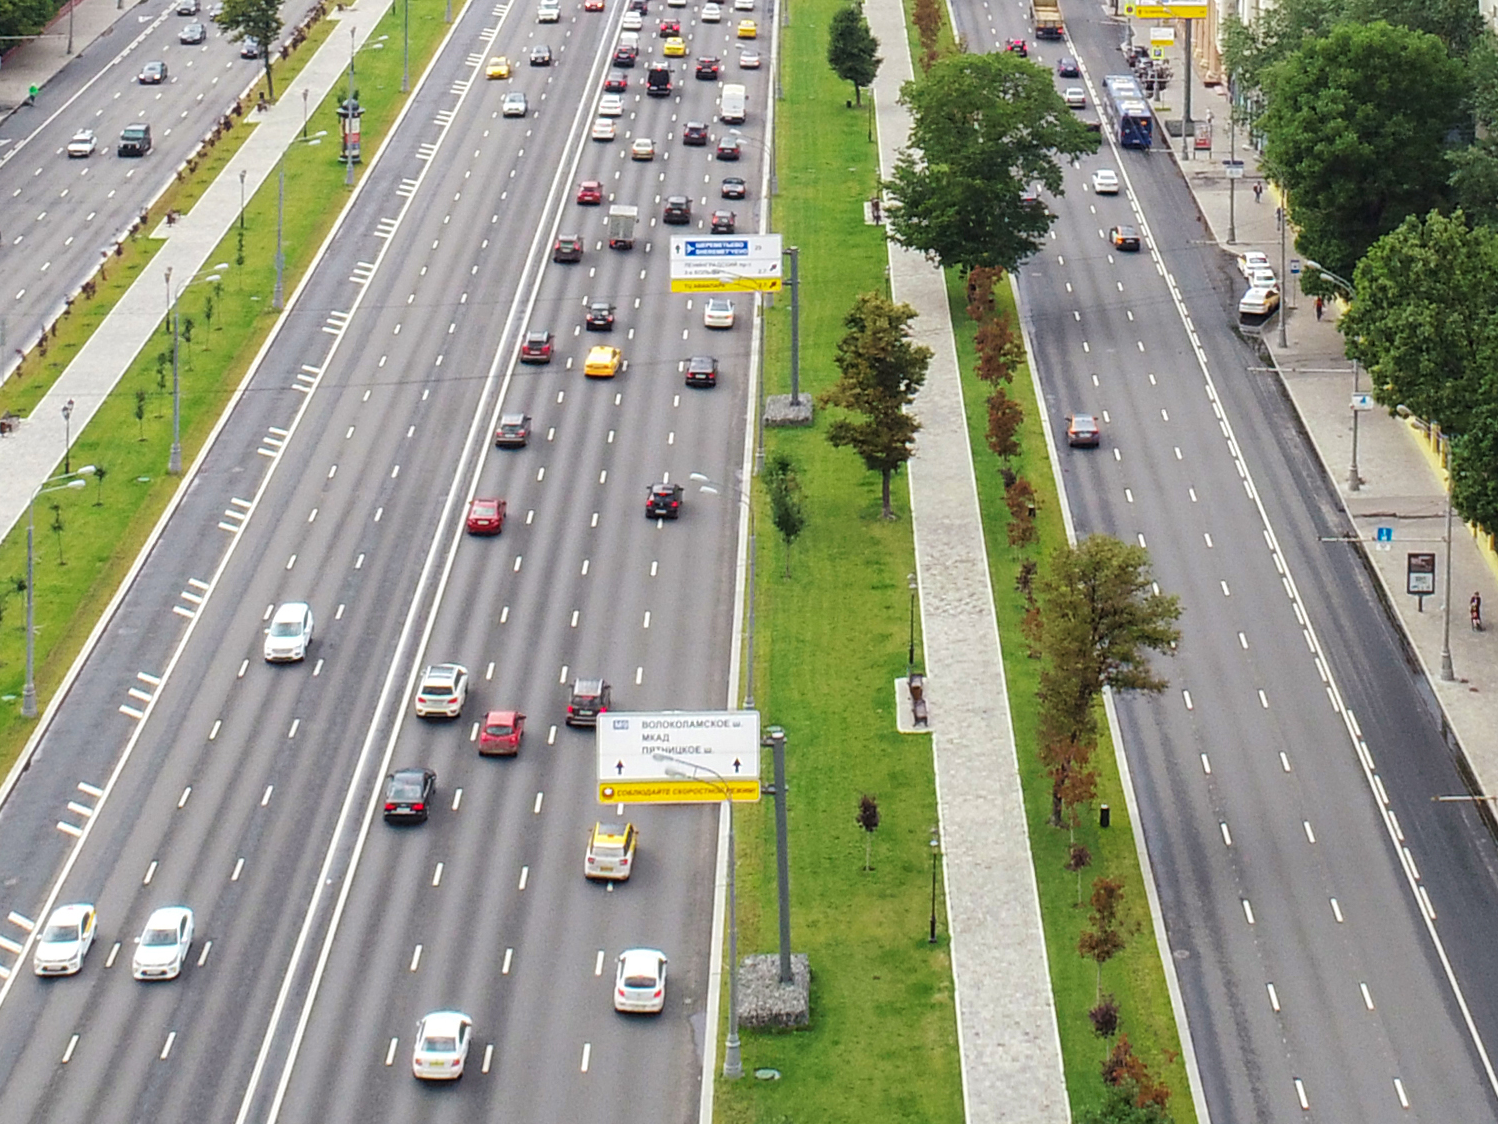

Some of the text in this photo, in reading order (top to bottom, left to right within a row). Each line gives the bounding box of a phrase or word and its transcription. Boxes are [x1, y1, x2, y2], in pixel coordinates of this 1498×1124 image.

[642, 720, 729, 729] ВОЛОКОЛАМСКОЕ
[642, 734, 670, 742] МКАД
[642, 746, 701, 755] ПЯТНИЦКОЕ
[617, 788, 671, 797] СОБЛЮДАЙТЕ
[673, 787, 723, 795] СКОРОСТНОЙ
